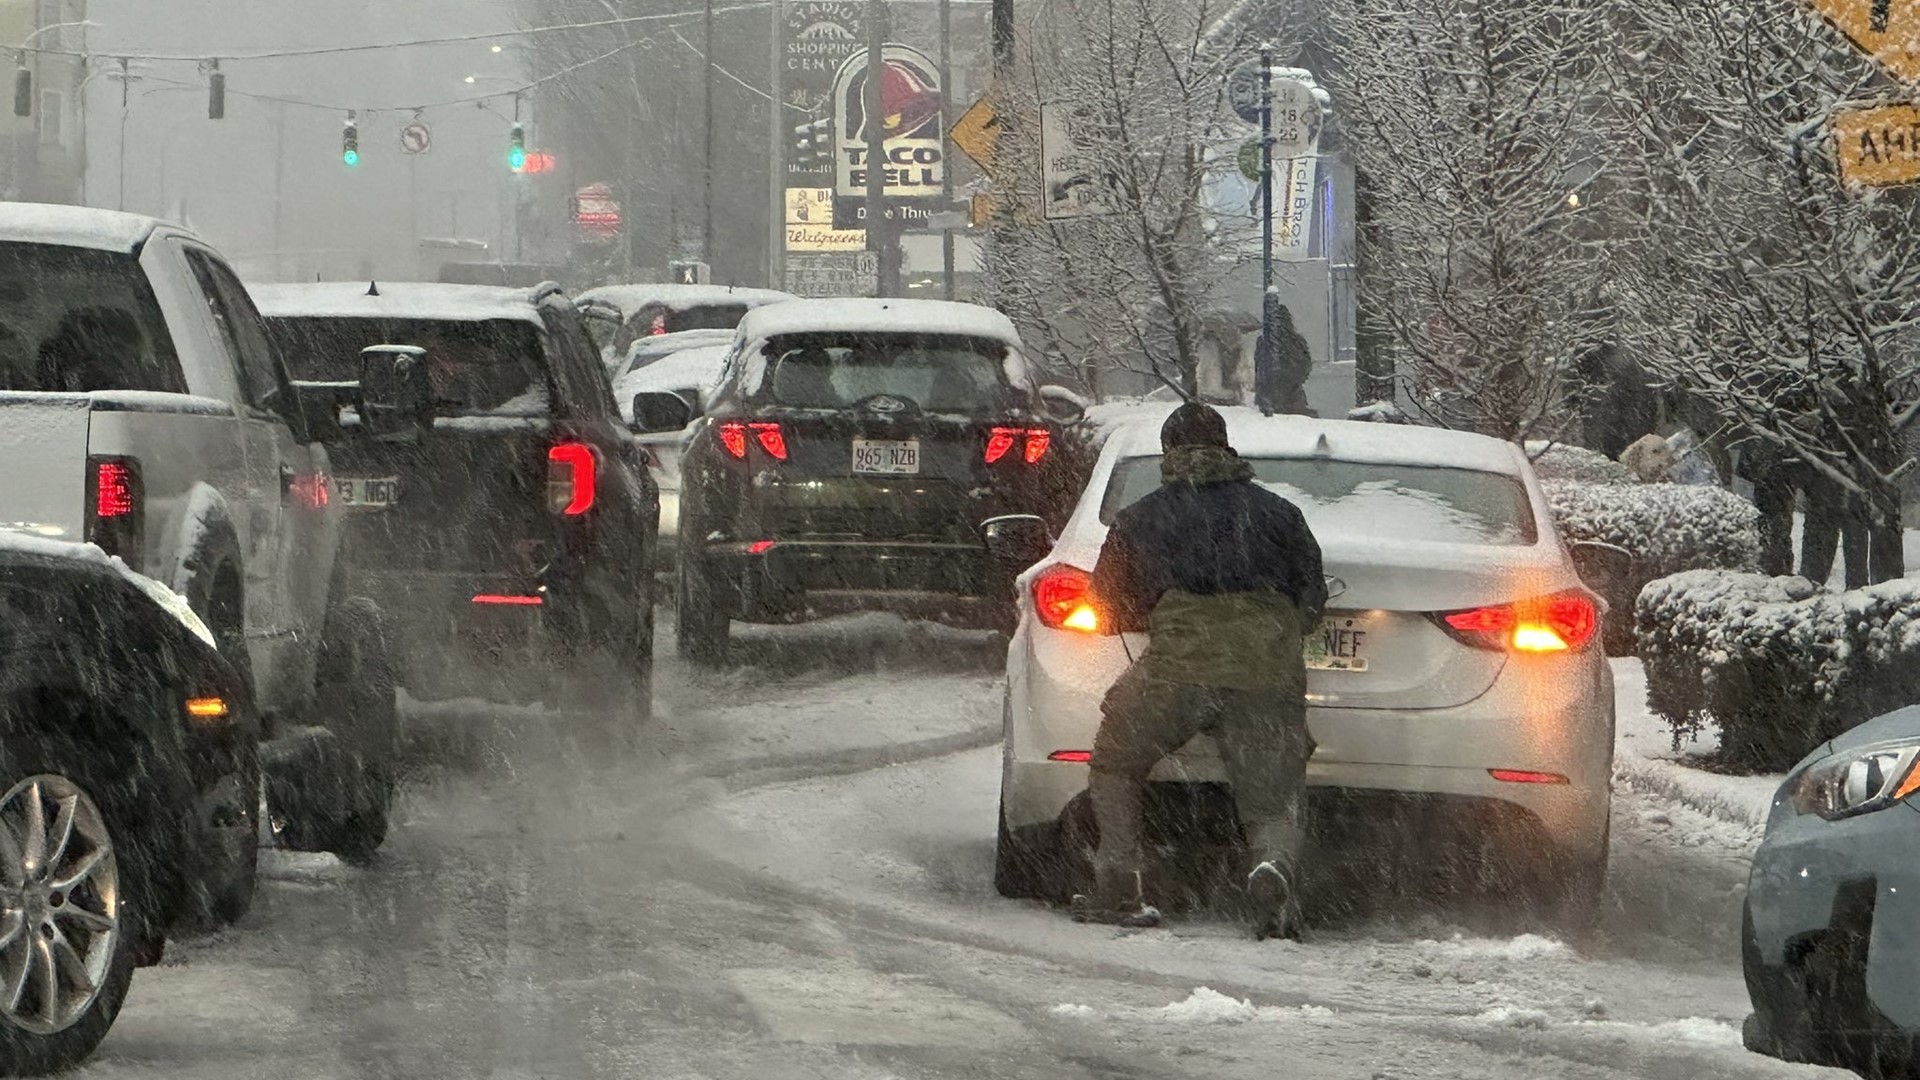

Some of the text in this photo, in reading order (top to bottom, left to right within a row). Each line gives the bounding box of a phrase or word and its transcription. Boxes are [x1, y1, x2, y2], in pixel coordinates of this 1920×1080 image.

[787, 58, 839, 71] CENT
[856, 448, 916, 465] 965 NZB
[1324, 627, 1367, 658] NEF
